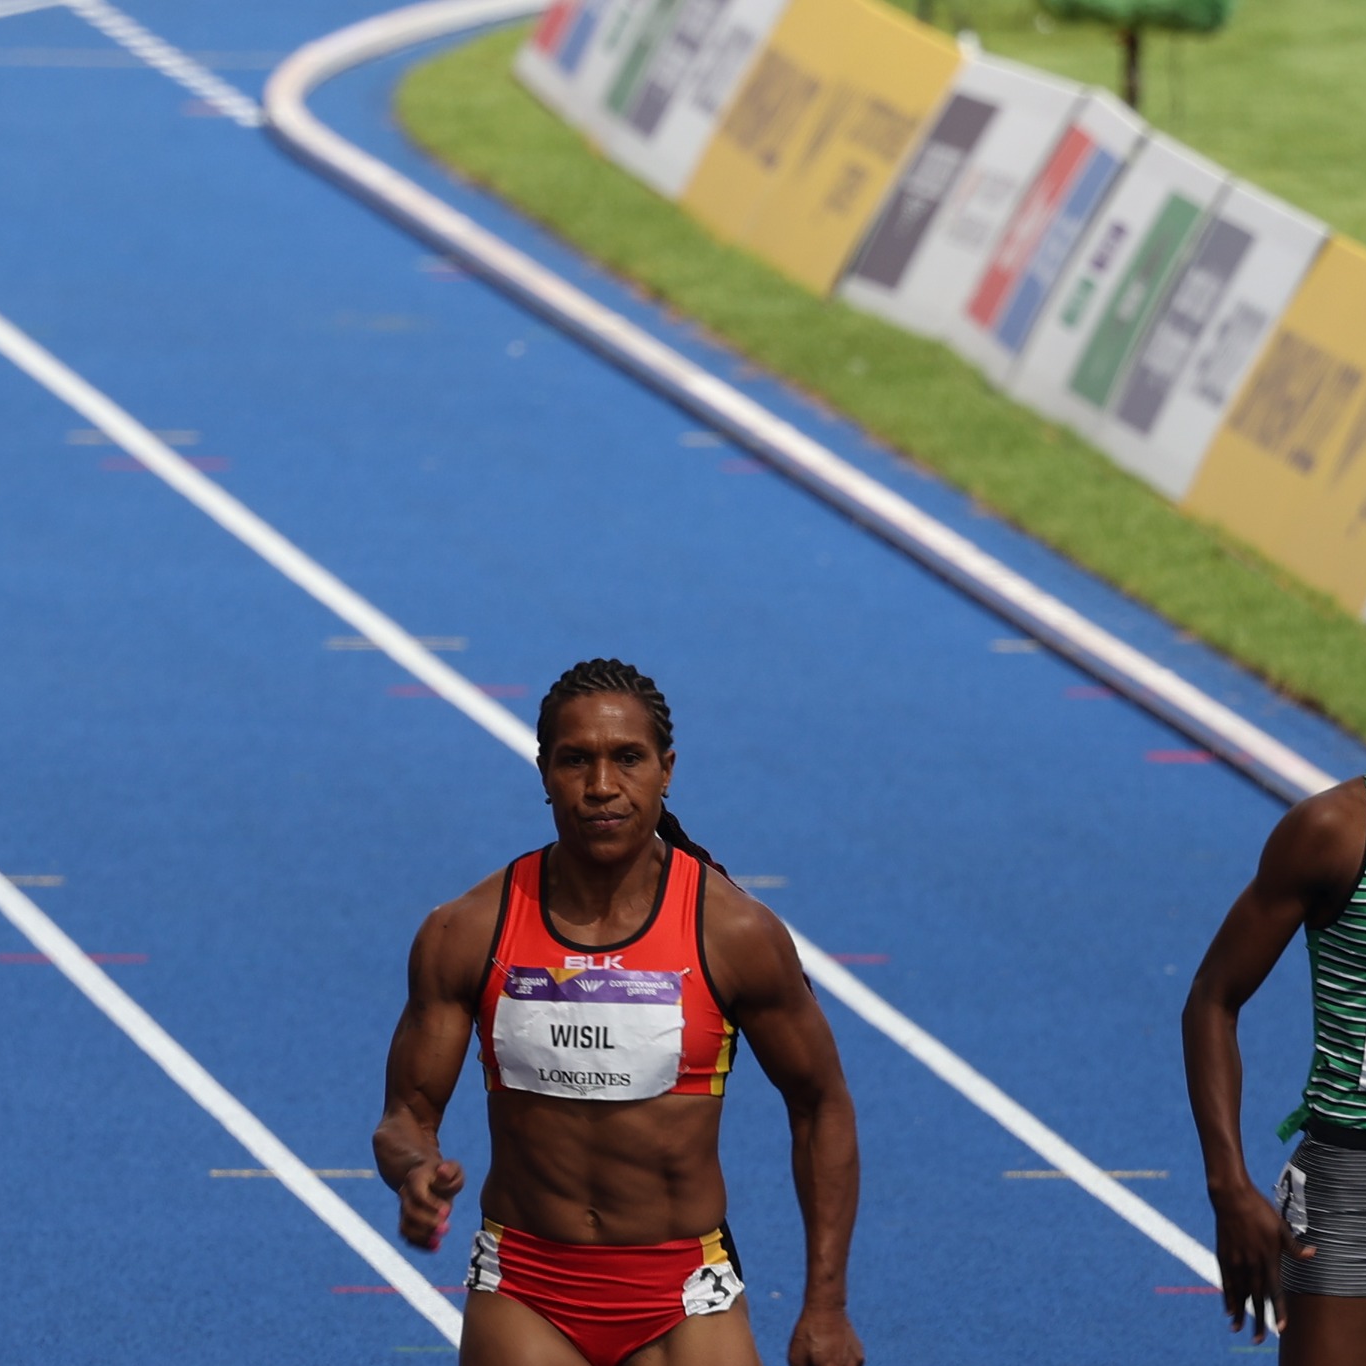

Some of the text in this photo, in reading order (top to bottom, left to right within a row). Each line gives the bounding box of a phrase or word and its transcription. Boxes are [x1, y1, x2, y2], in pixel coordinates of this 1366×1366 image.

[563, 955, 625, 970] BLK
[550, 1024, 615, 1050] WISIL
[538, 1068, 632, 1087] LONGINES
